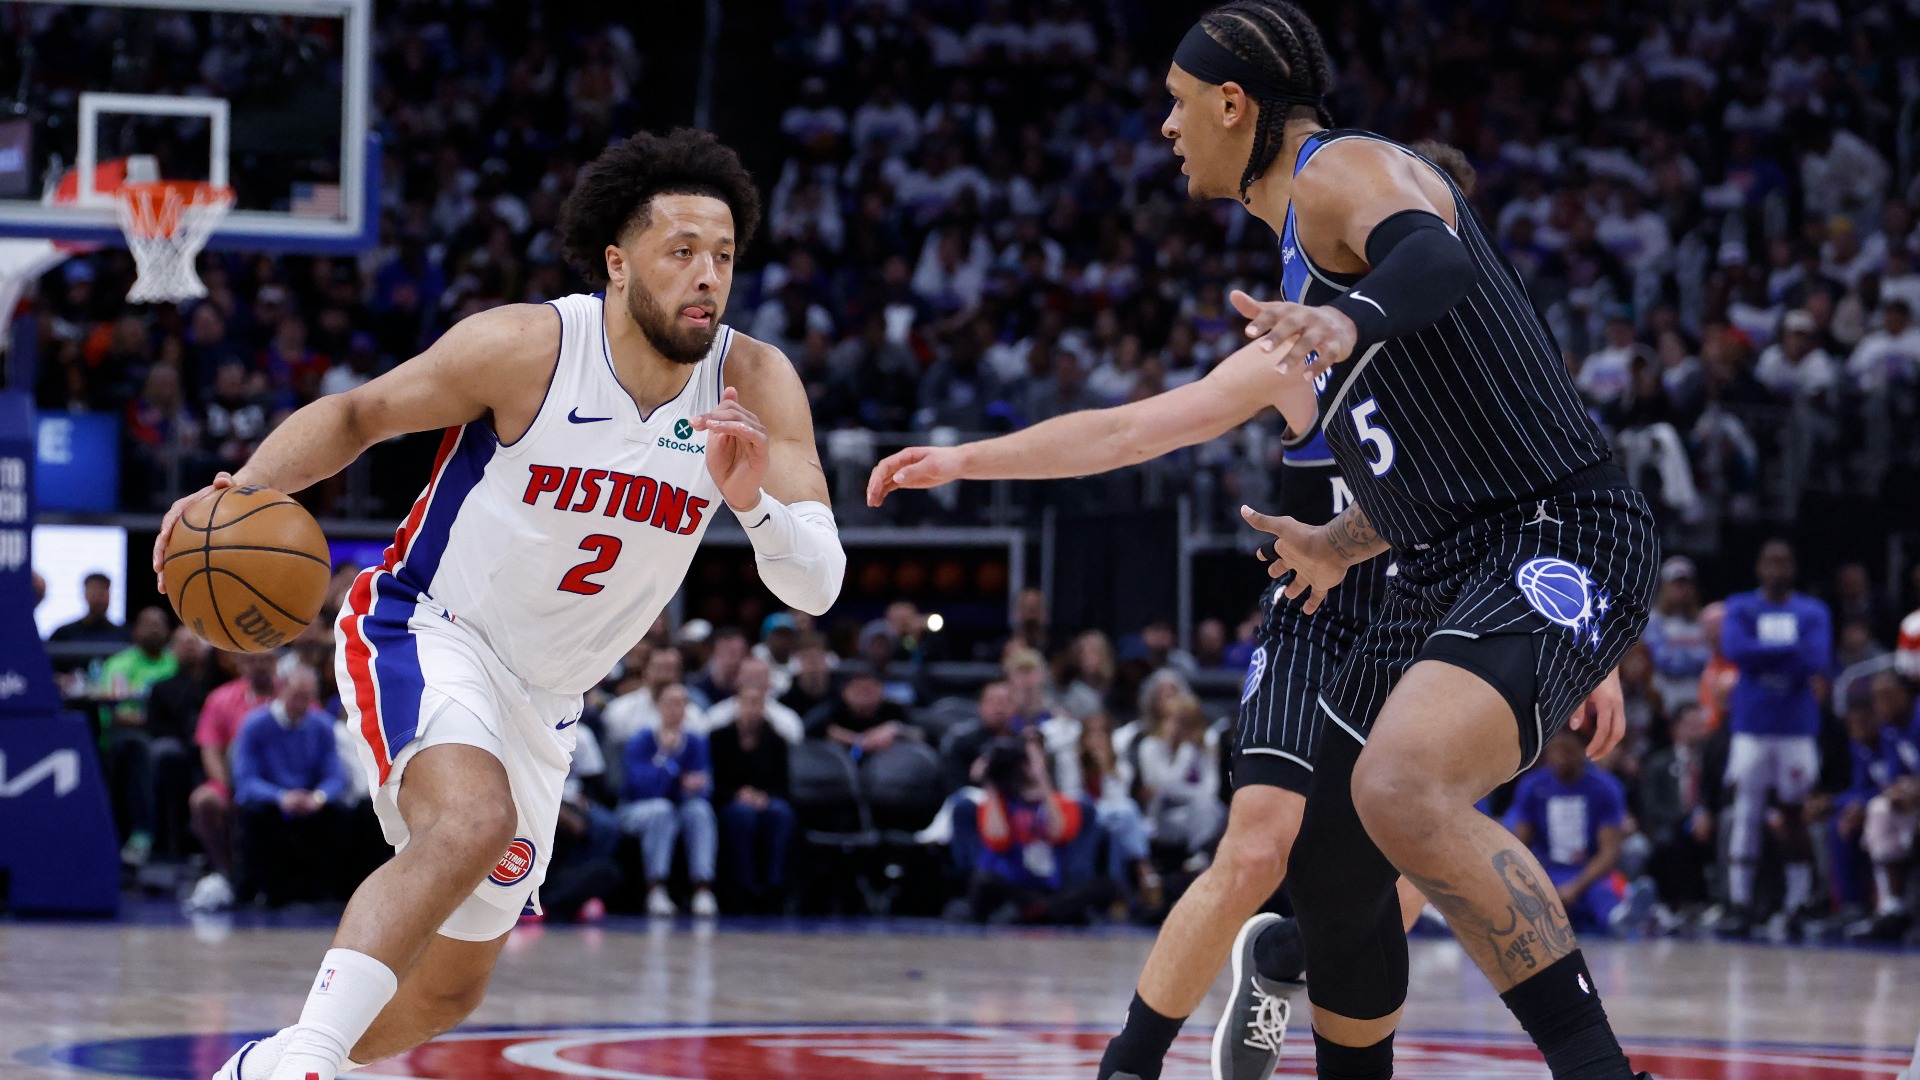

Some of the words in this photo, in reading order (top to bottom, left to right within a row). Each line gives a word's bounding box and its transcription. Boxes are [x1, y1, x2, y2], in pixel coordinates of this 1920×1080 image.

[657, 437, 705, 454] StockX
[1350, 394, 1396, 478] 5
[522, 464, 709, 535] PISTONS
[557, 533, 622, 595] 2
[498, 858, 522, 875] ISTONS
[1505, 931, 1536, 961] DUKE
[1520, 947, 1537, 968] 5
